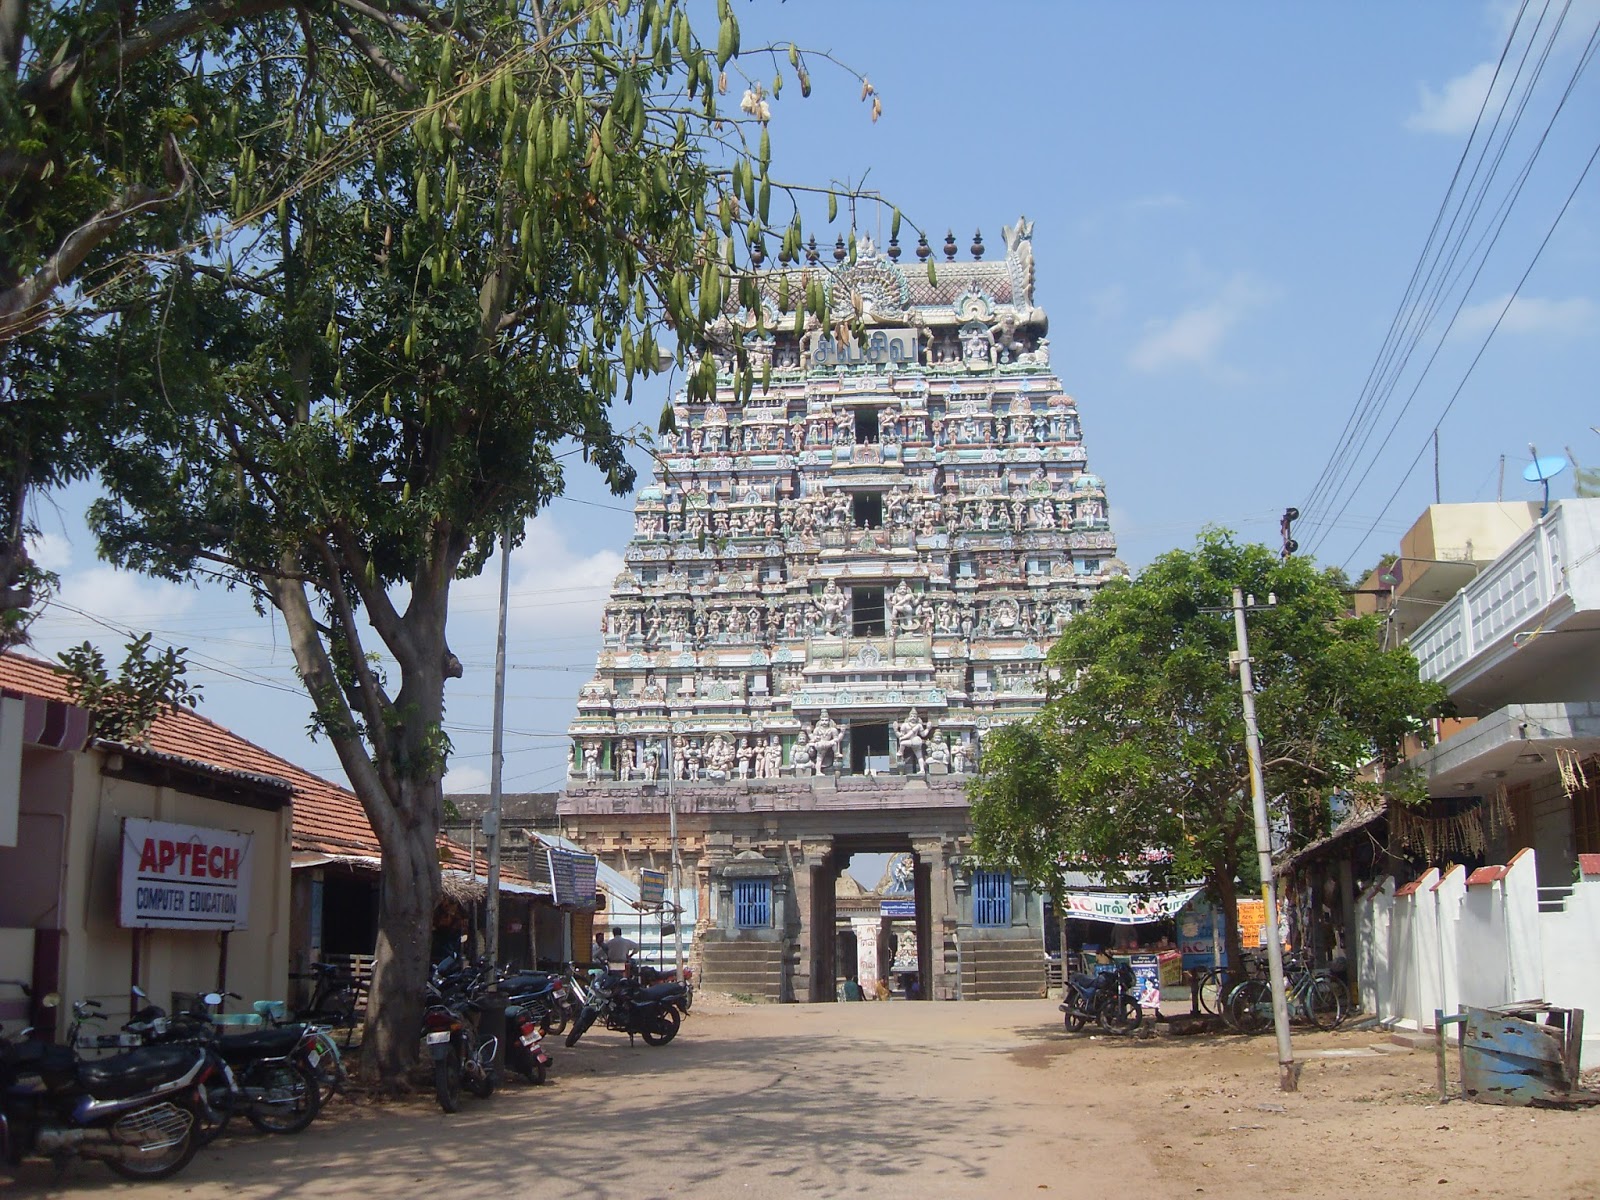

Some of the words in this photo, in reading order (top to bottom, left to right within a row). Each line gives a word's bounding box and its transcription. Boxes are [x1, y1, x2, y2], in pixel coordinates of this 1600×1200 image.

[139, 838, 240, 880] APTECH
[137, 887, 185, 912] COMPUTER
[189, 891, 237, 914] EDUCATION
